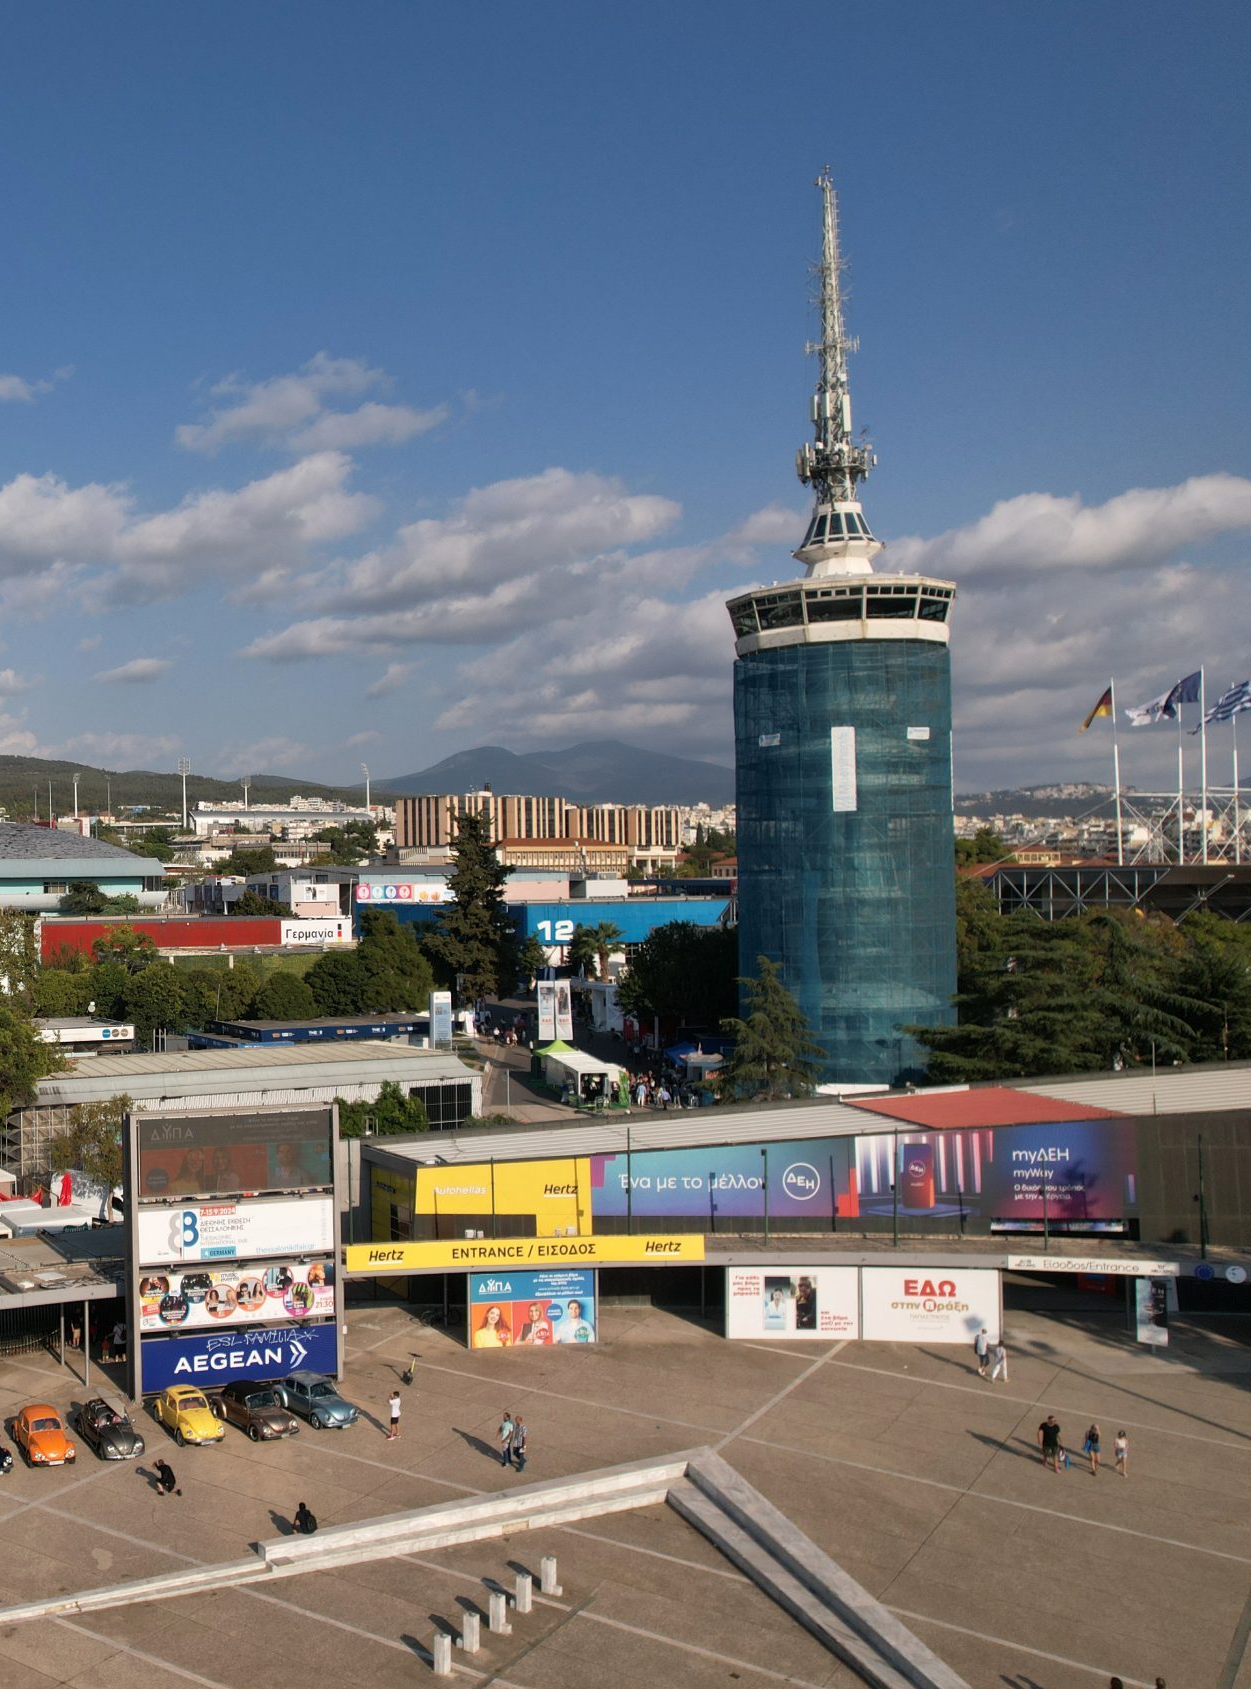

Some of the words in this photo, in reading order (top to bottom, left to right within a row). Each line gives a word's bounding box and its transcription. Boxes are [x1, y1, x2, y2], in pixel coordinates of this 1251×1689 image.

[286, 928, 334, 942] Γερμανία
[537, 920, 574, 940] 12
[544, 1183, 578, 1195] Hertz
[656, 1176, 677, 1192] με
[681, 1176, 702, 1189] το
[786, 1173, 815, 1190] ΔΕΗ
[369, 1250, 404, 1261] Hertz
[452, 1246, 524, 1259] ENTRANCE
[538, 1243, 596, 1257] ΕΙΣΟΔΟΣ
[645, 1241, 681, 1253] Hertz
[479, 1278, 512, 1293] ΔΥΠΑ
[904, 1279, 956, 1297] ΕΔΩ
[174, 1347, 282, 1374] AEGEAN
